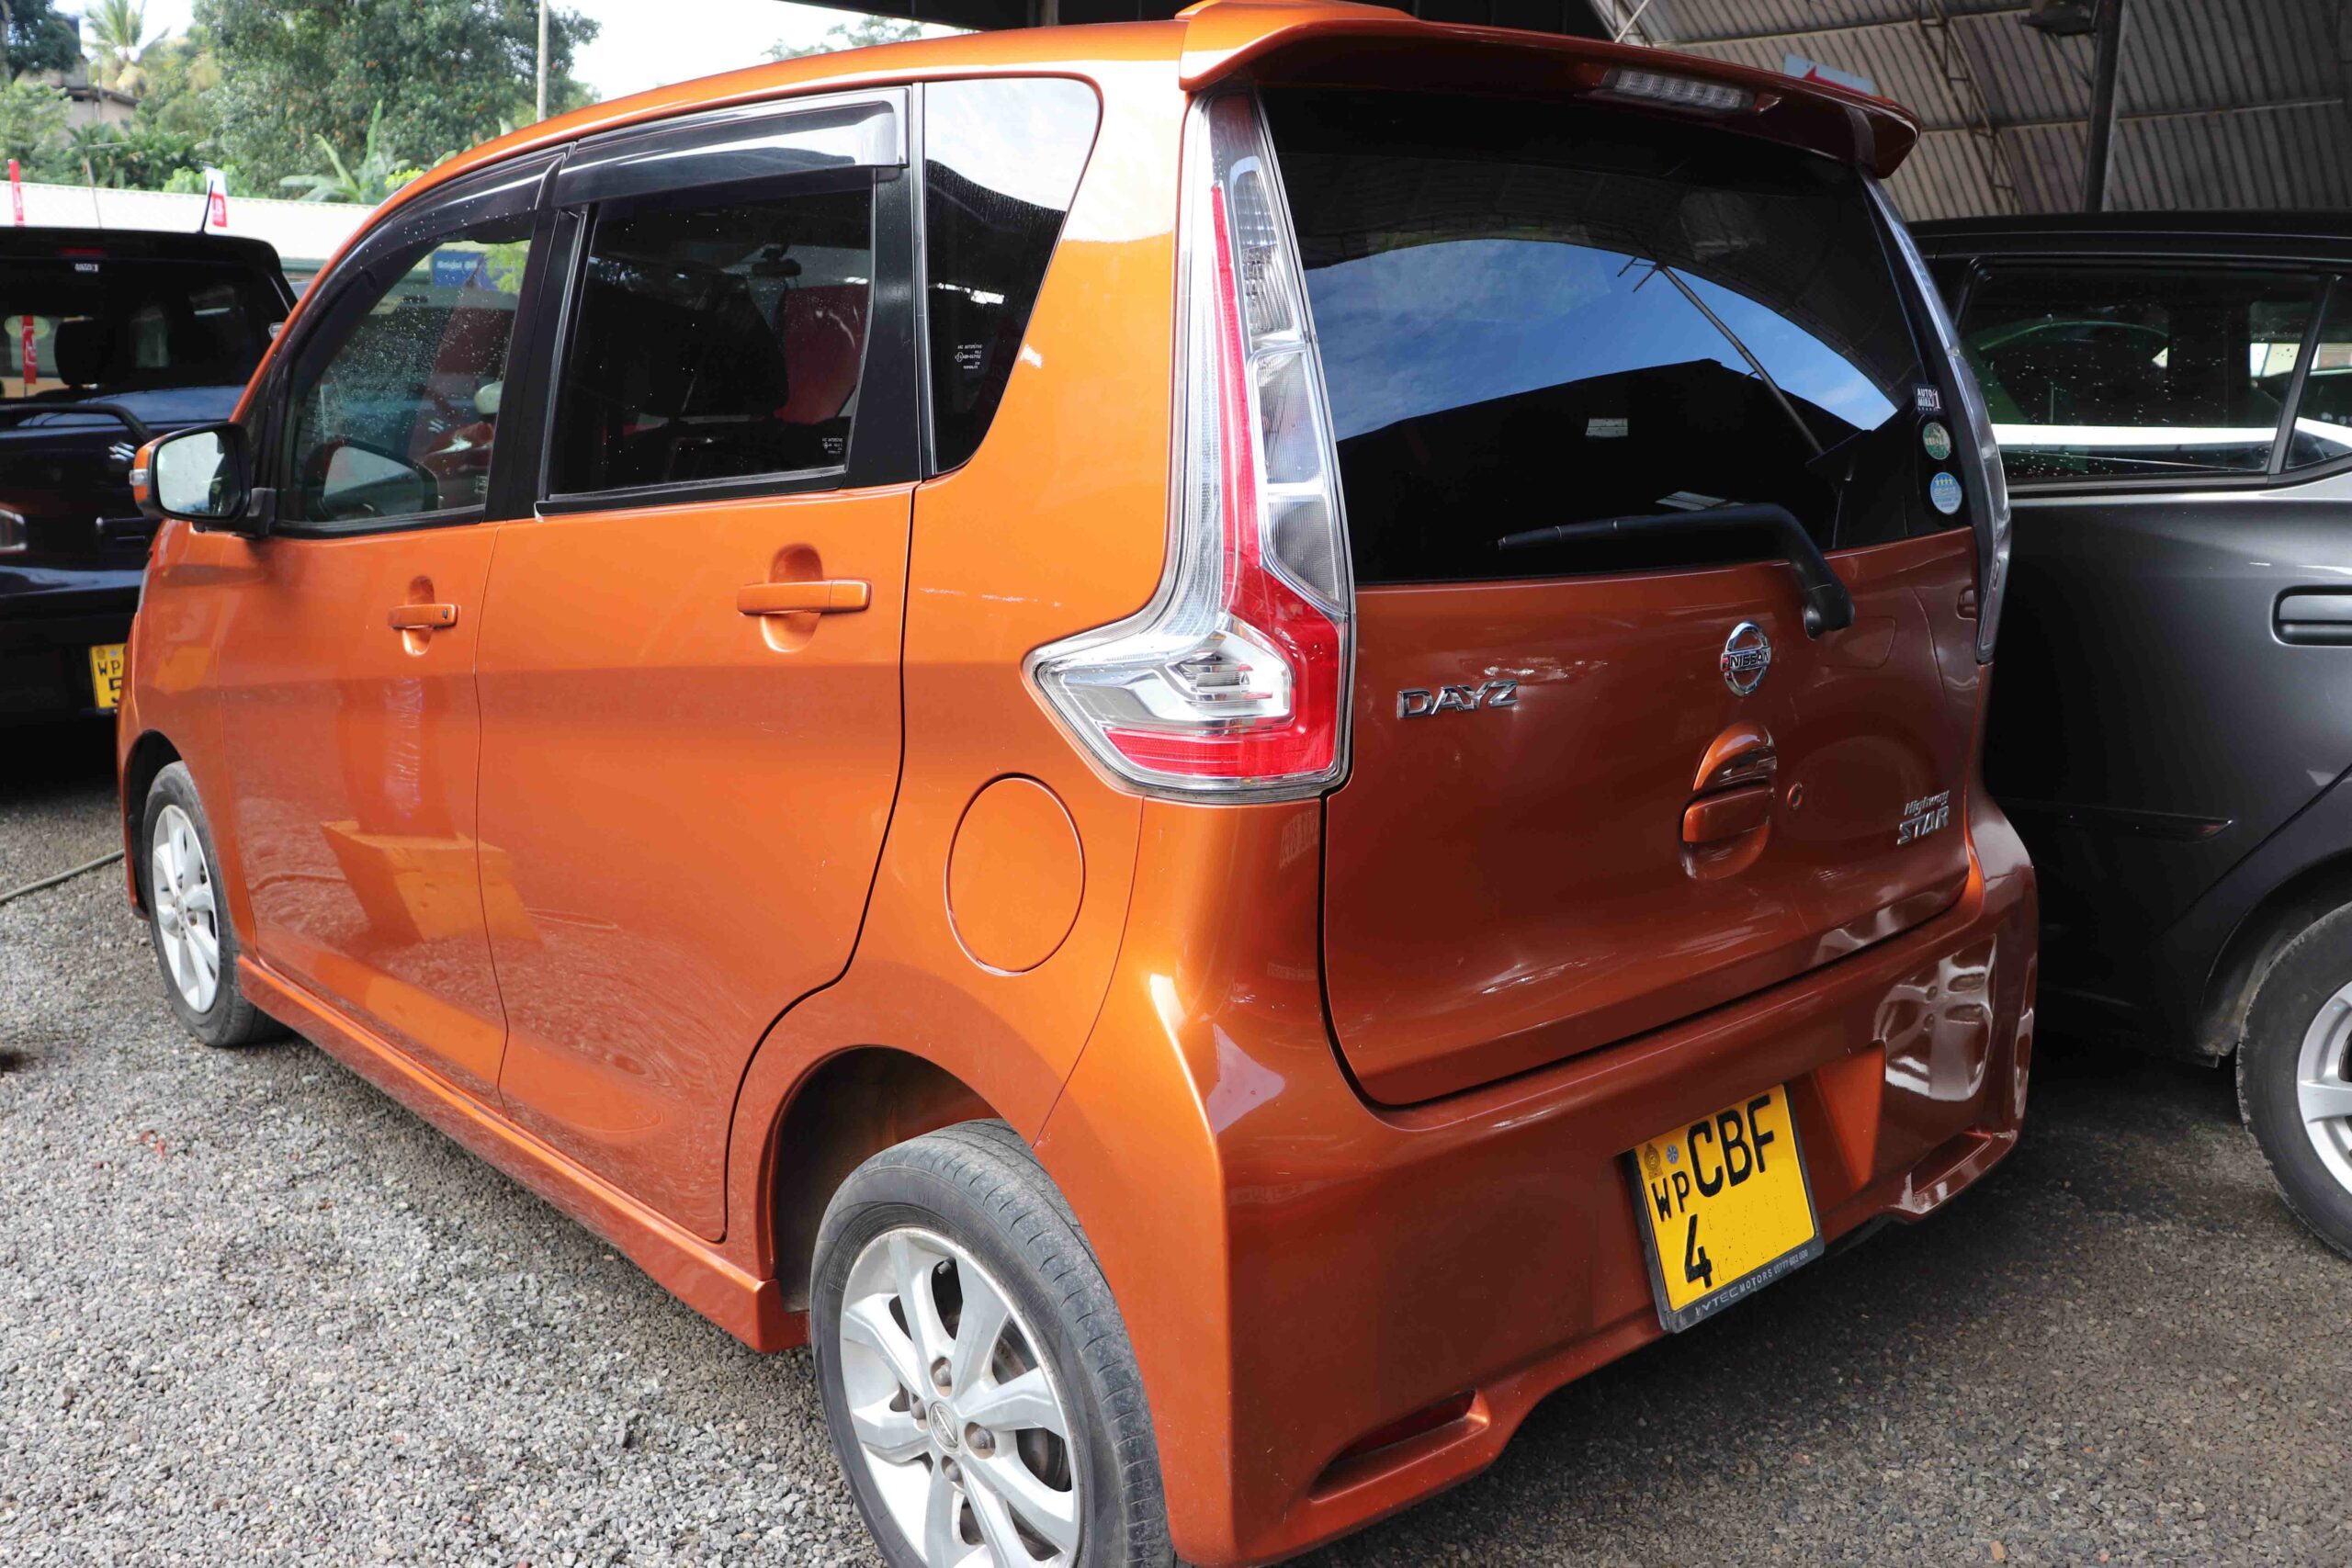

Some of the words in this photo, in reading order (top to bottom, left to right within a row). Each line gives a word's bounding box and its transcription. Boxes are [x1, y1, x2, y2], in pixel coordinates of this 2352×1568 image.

[1917, 388, 1933, 397] AUTO
[97, 660, 120, 676] WP
[1730, 650, 1770, 668] NISSAN
[1396, 680, 1519, 720] DAYZ
[1904, 790, 1950, 817] Highway
[1896, 806, 1950, 845] STAR
[1651, 1170, 1690, 1223] WP
[1687, 1093, 1775, 1198] CBF
[1683, 1213, 1713, 1289] 4
[1739, 1269, 1772, 1293] MOTORS
